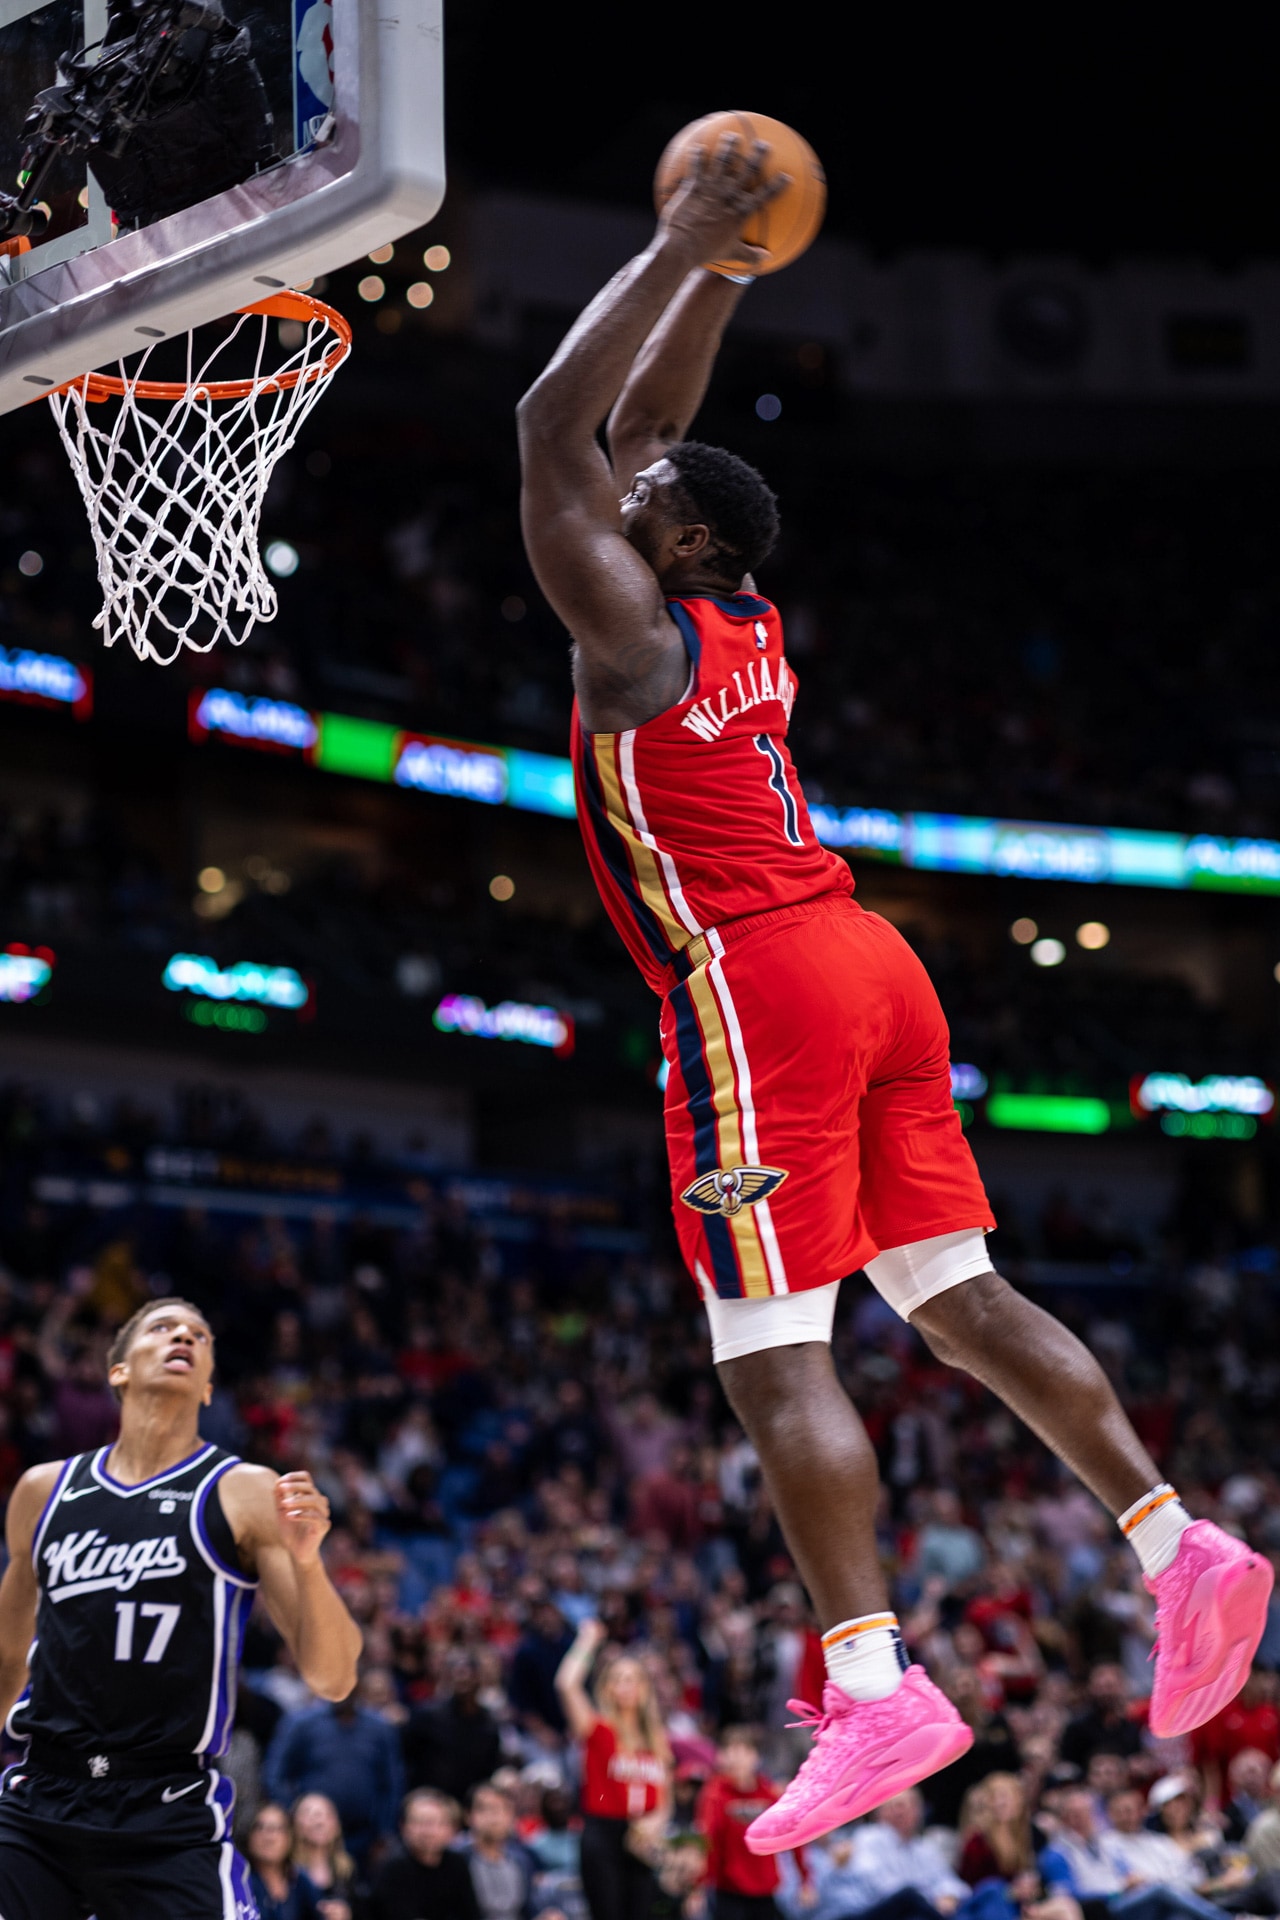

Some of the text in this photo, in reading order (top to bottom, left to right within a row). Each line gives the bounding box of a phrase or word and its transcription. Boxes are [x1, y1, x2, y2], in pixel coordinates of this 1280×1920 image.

[752, 732, 806, 847] 1
[42, 1528, 187, 1596] Kings
[114, 1601, 182, 1663] 17
